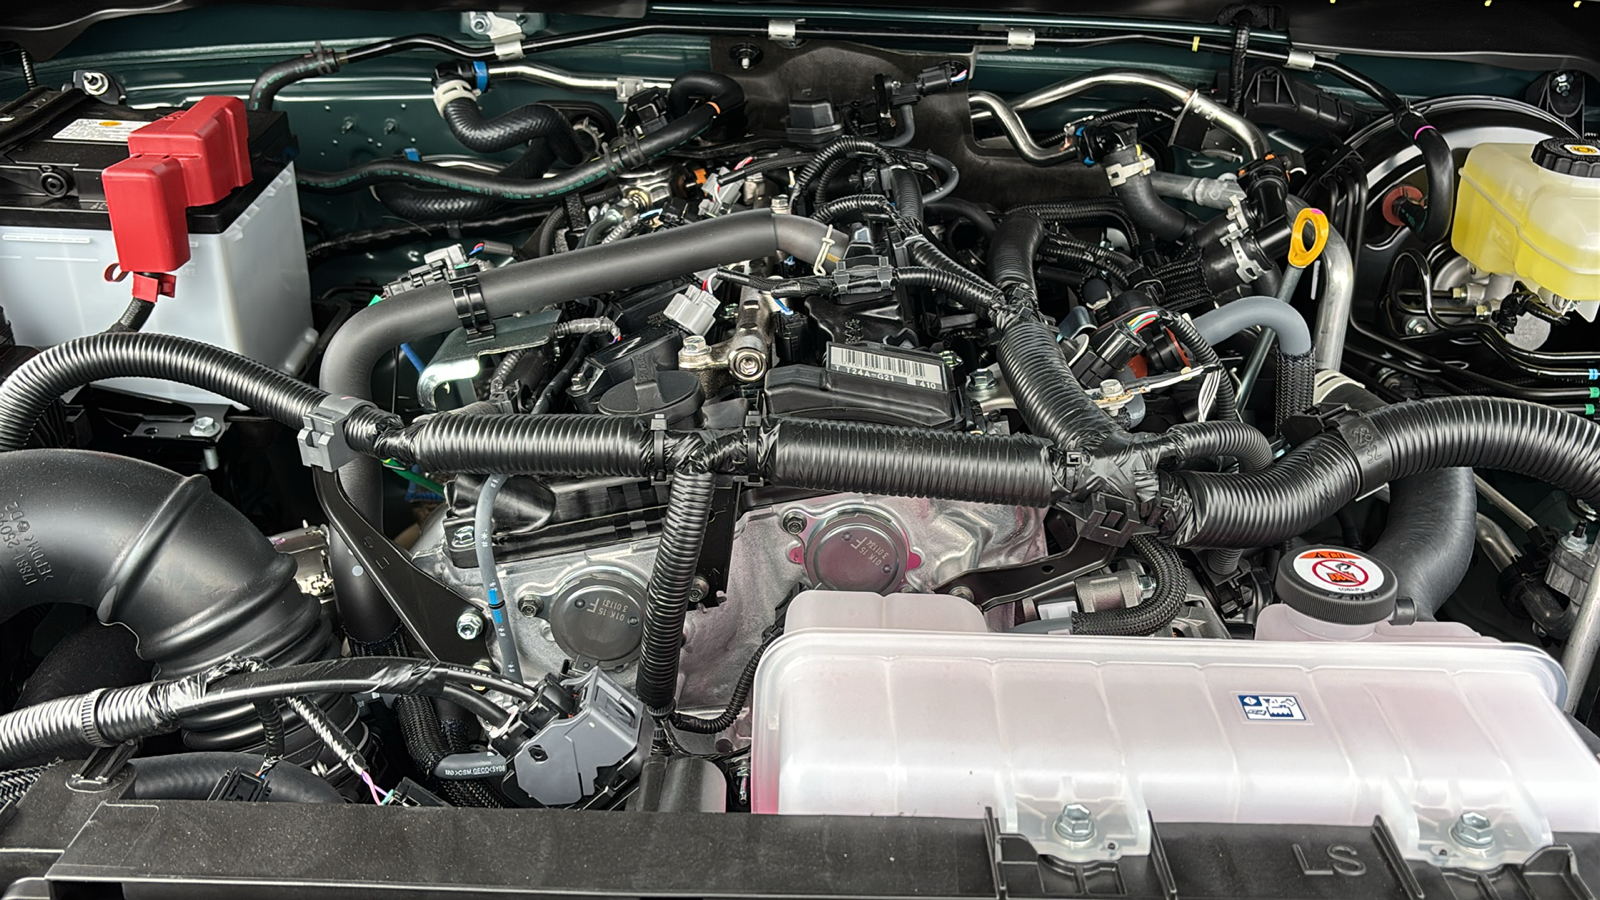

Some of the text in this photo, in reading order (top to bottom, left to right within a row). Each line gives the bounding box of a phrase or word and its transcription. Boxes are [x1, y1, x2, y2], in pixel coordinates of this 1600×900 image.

[846, 367, 895, 382] T24A-G21
[919, 381, 937, 390] 410
[850, 536, 868, 550] F
[586, 597, 600, 613] F
[1292, 843, 1367, 876] LS
